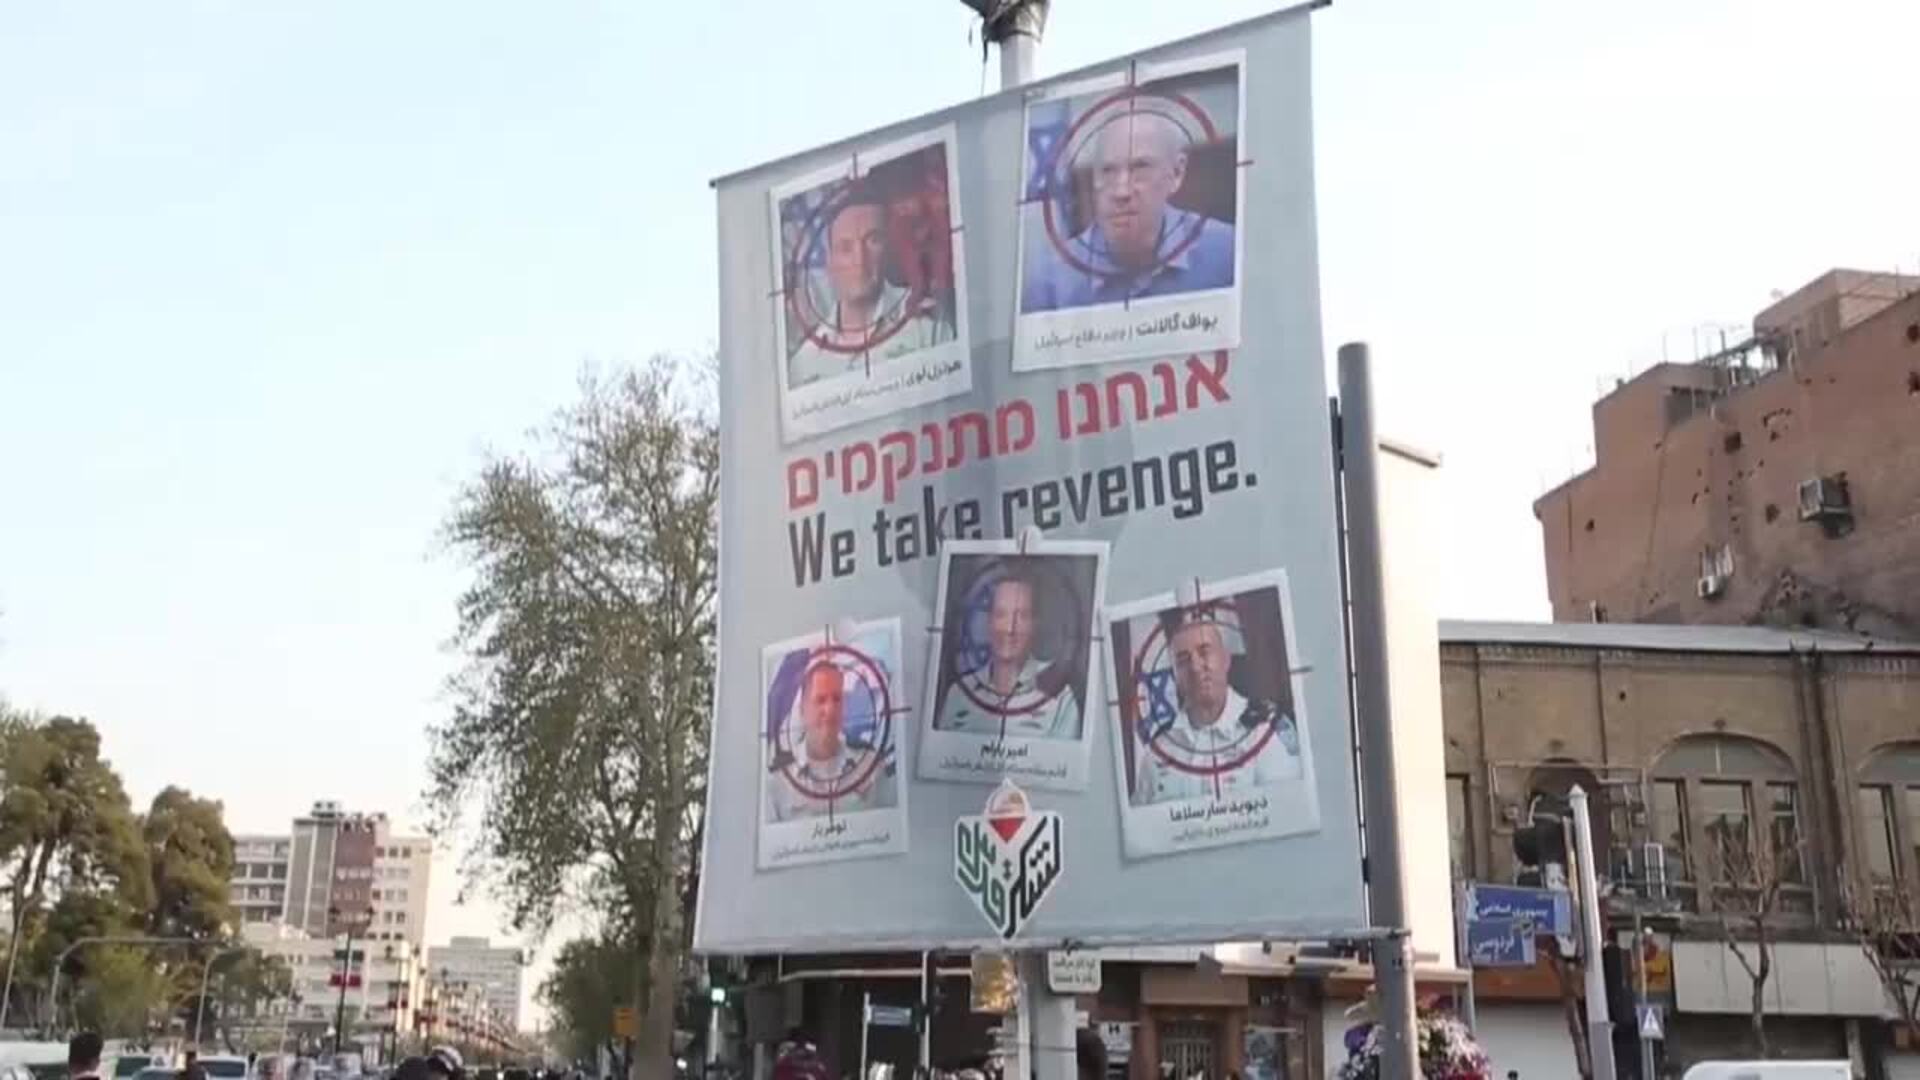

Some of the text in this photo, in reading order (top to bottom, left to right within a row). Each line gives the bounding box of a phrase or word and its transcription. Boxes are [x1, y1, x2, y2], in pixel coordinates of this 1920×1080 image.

[786, 349, 1231, 510] אנחנו מתנקמים
[789, 440, 1258, 588] We take revenge.
